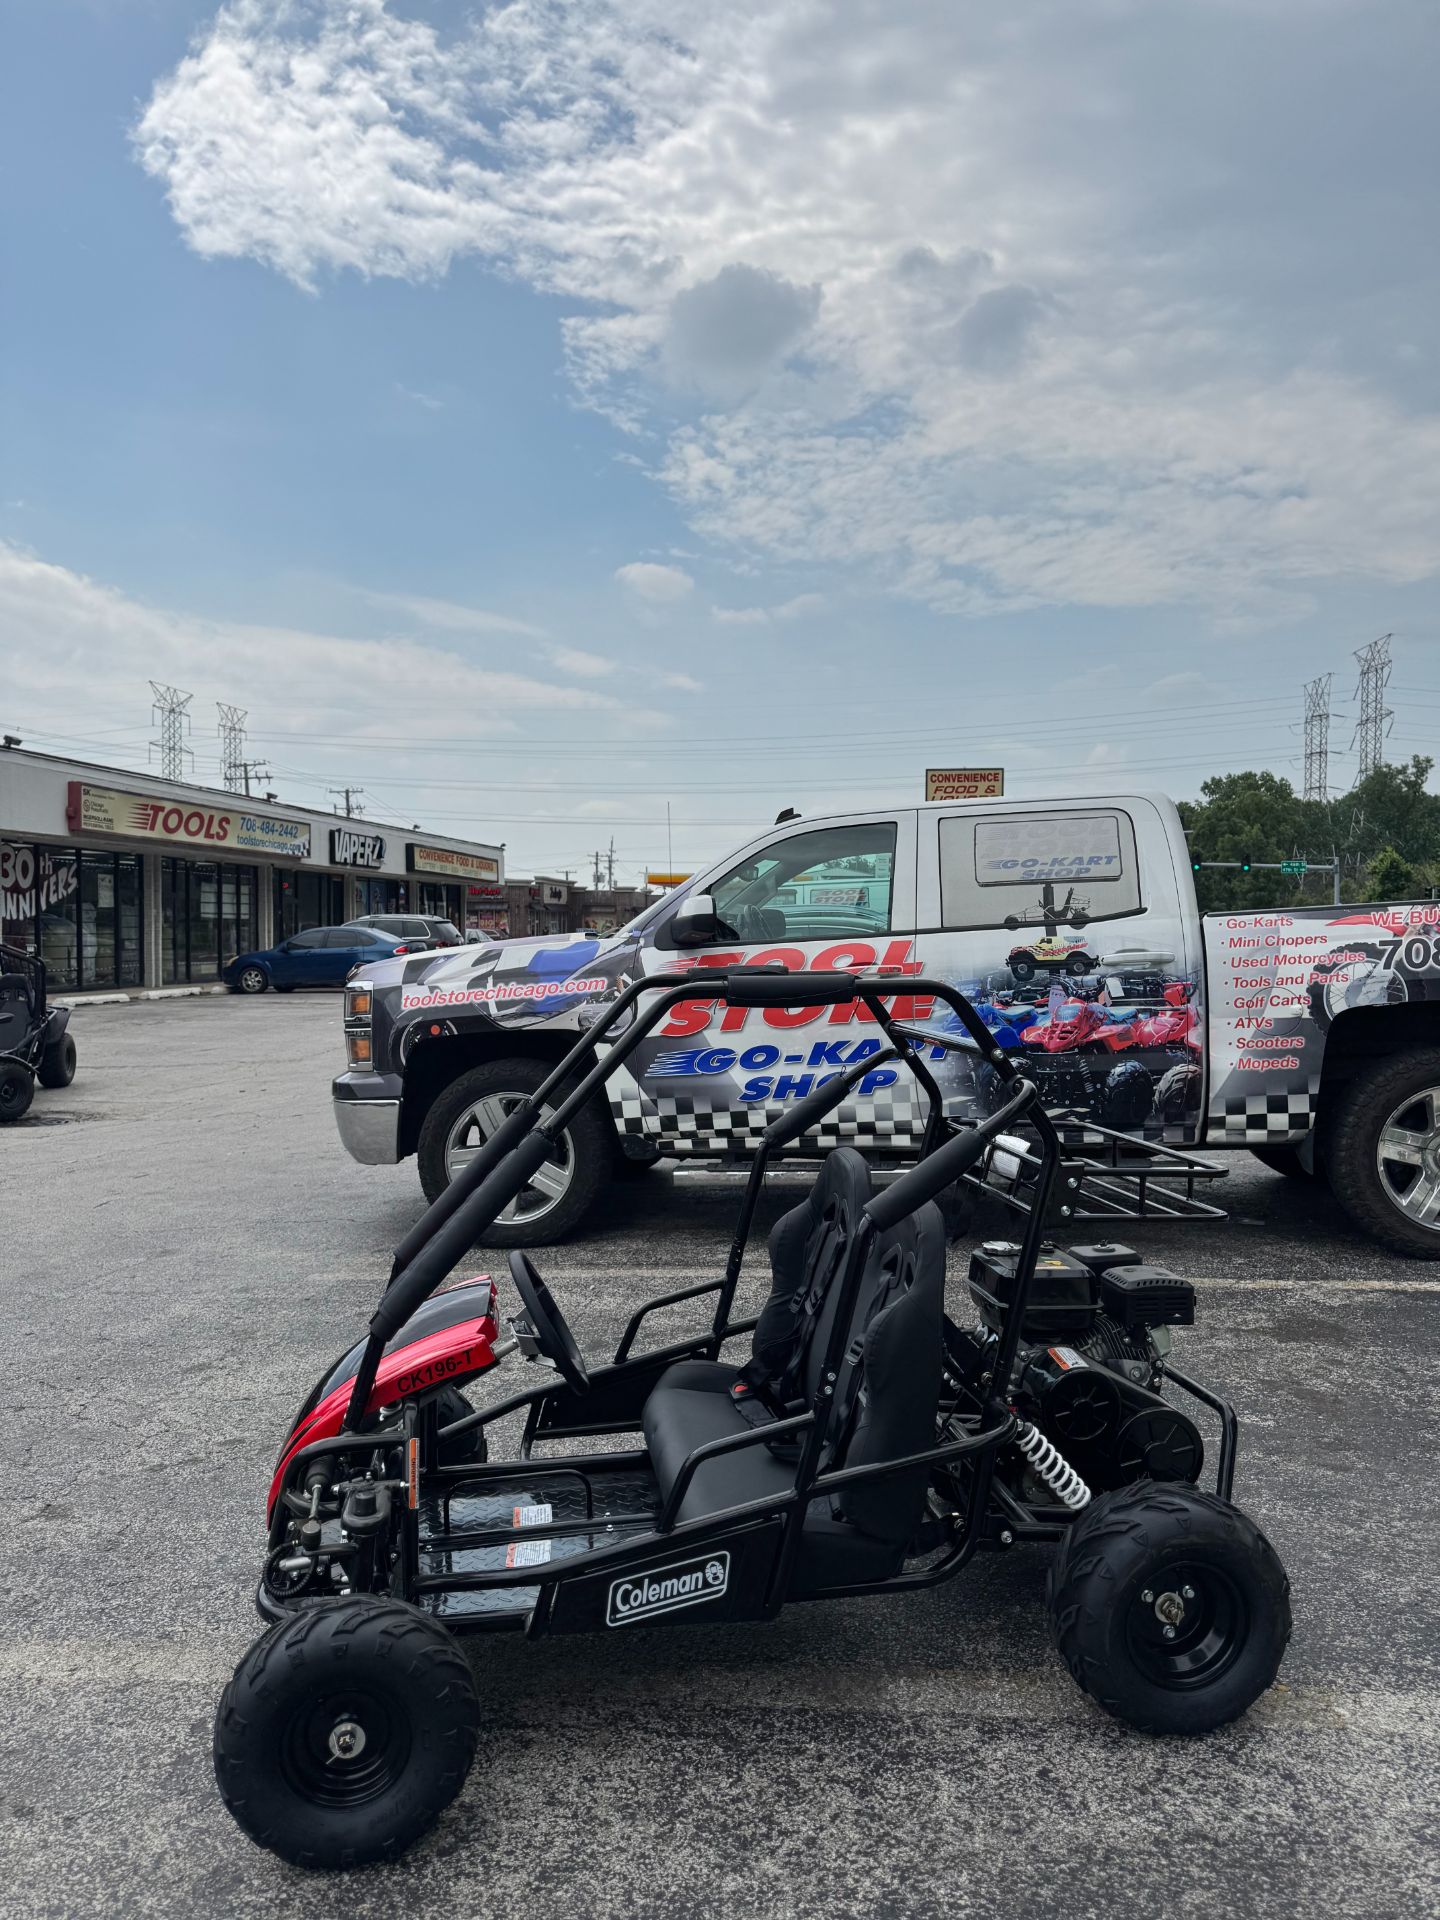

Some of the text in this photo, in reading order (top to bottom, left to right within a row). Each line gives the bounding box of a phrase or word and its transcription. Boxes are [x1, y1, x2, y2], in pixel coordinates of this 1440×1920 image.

[930, 773, 1000, 783] CONVENIENCE
[934, 785, 996, 794] FOOD &
[149, 804, 230, 841] TOOLS
[240, 816, 299, 839] 708-484-2442
[237, 834, 302, 853] toolstorechicago.com
[419, 849, 455, 865] CONVENIENCE
[1001, 855, 1118, 869] GO-KART
[0, 843, 53, 889] 30 th
[1020, 867, 1091, 880] SHOP
[1226, 916, 1294, 929] Go-Karts
[1371, 908, 1440, 926] WE BU
[1229, 934, 1328, 949] Mini Chopers
[1231, 952, 1366, 968] Used Motorcycles
[1233, 972, 1349, 988] Tools and Parts
[403, 978, 606, 1009] toolstorechicago.com
[1233, 994, 1311, 1009] Golf Carts
[1234, 1017, 1273, 1028] ATVs
[1236, 1037, 1304, 1049] Scooters
[1238, 1056, 1298, 1071] Mopeds
[397, 1347, 474, 1392] CK196-T
[616, 1571, 703, 1612] Coleman
